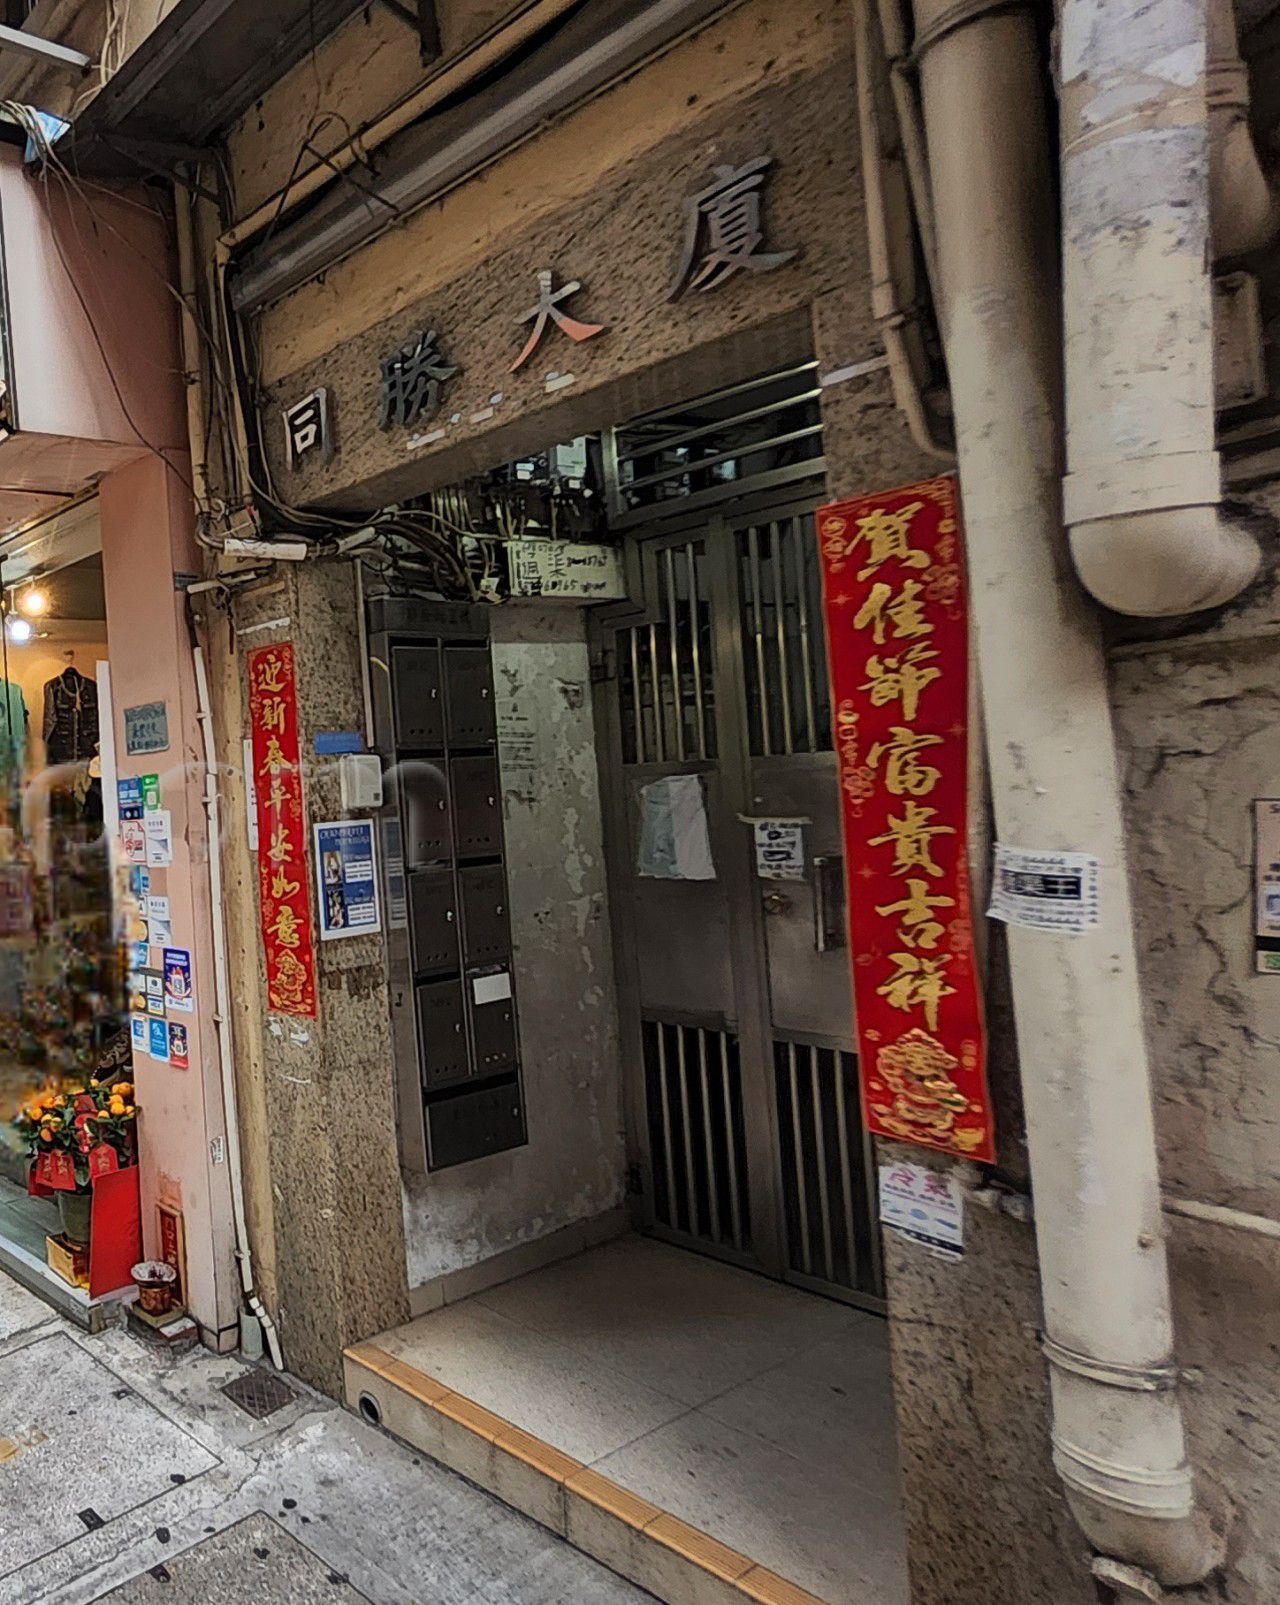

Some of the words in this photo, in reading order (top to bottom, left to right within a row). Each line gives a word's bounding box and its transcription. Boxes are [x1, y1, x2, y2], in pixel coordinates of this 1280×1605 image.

[283, 155, 798, 470] 同勝大廈
[257, 654, 304, 948] 迎新春平安如意
[844, 501, 958, 1031] 賀佳節富貴吉祥
